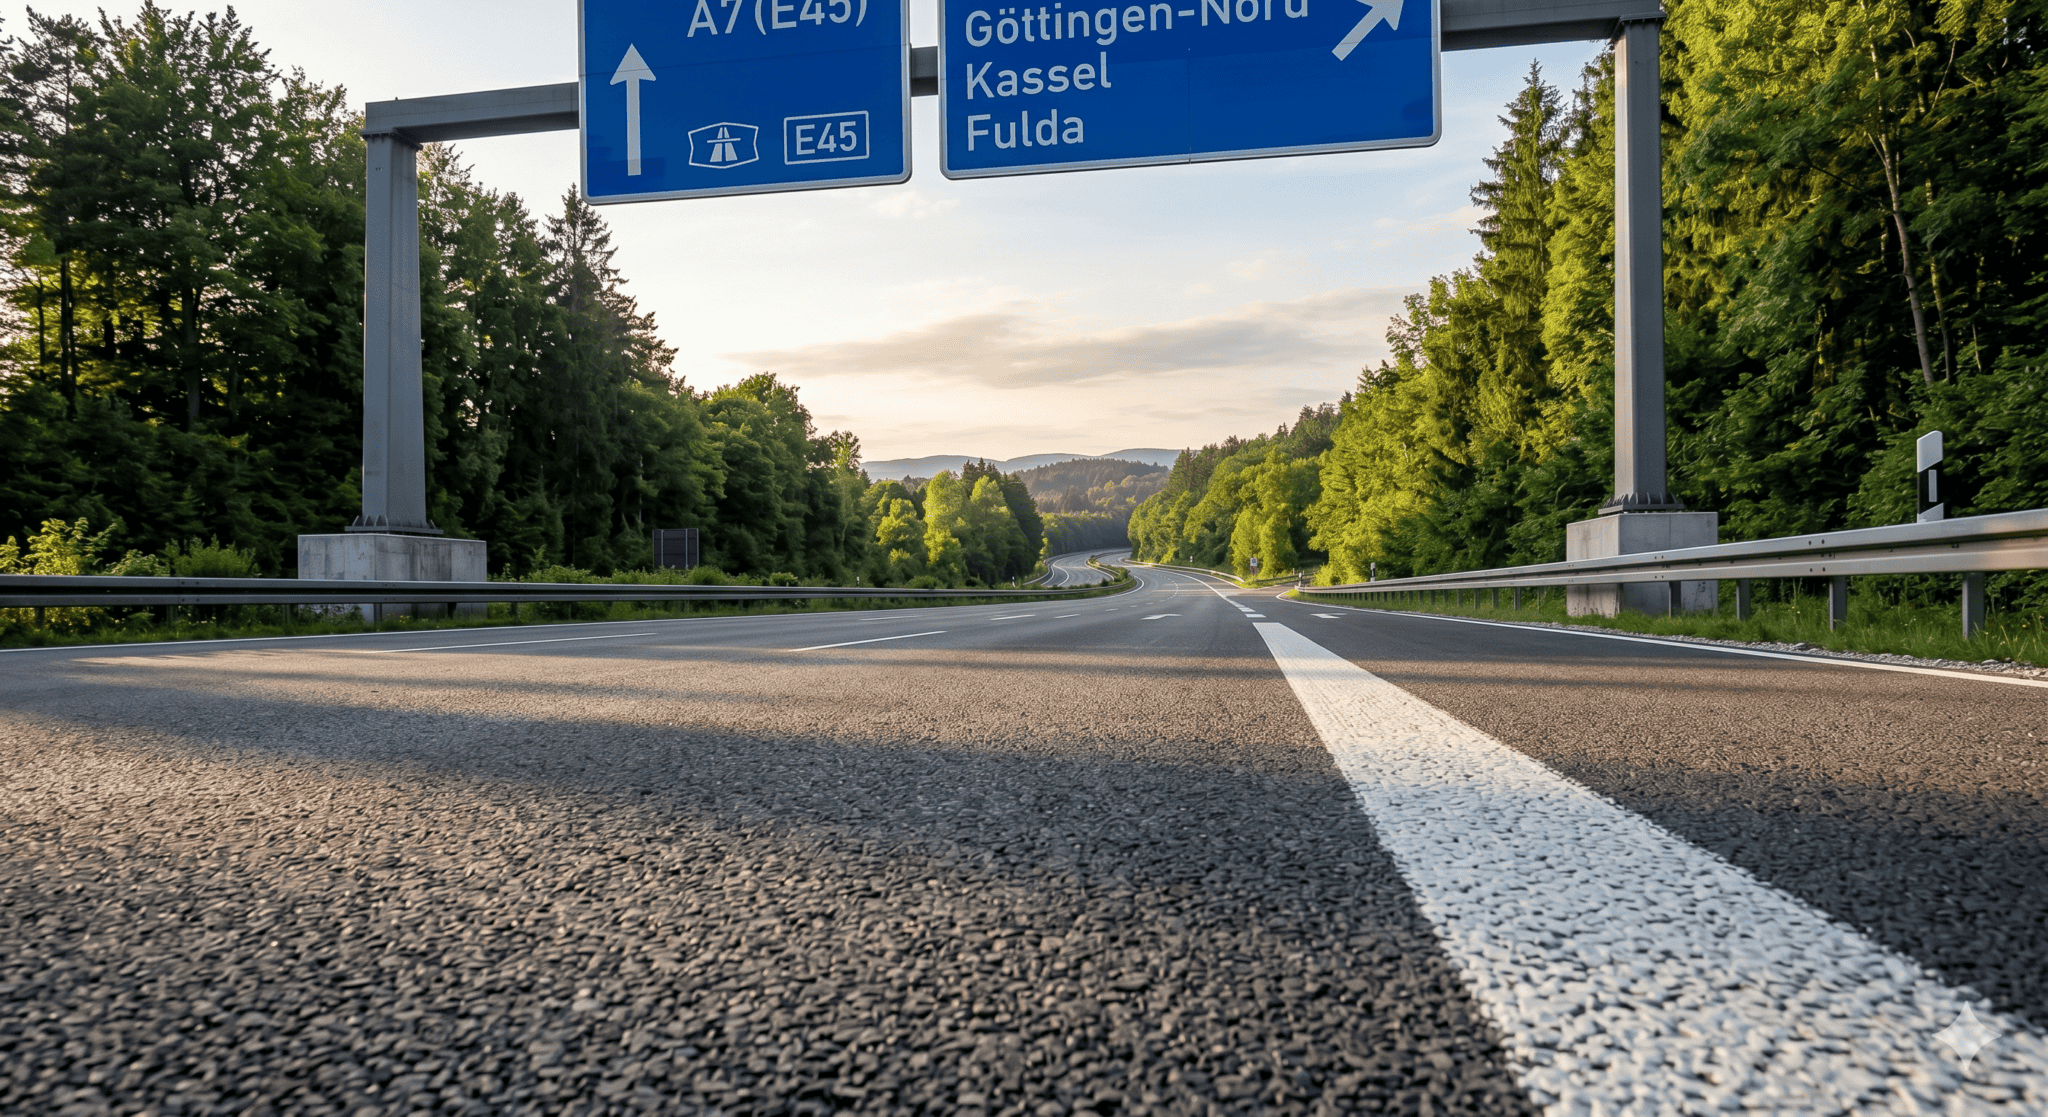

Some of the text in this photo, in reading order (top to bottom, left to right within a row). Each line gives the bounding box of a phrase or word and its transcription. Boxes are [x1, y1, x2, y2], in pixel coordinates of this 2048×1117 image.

[687, 0, 743, 37] A7
[966, 52, 1111, 99] Kassel
[796, 121, 857, 155] E45
[967, 109, 1084, 151] Fulda
